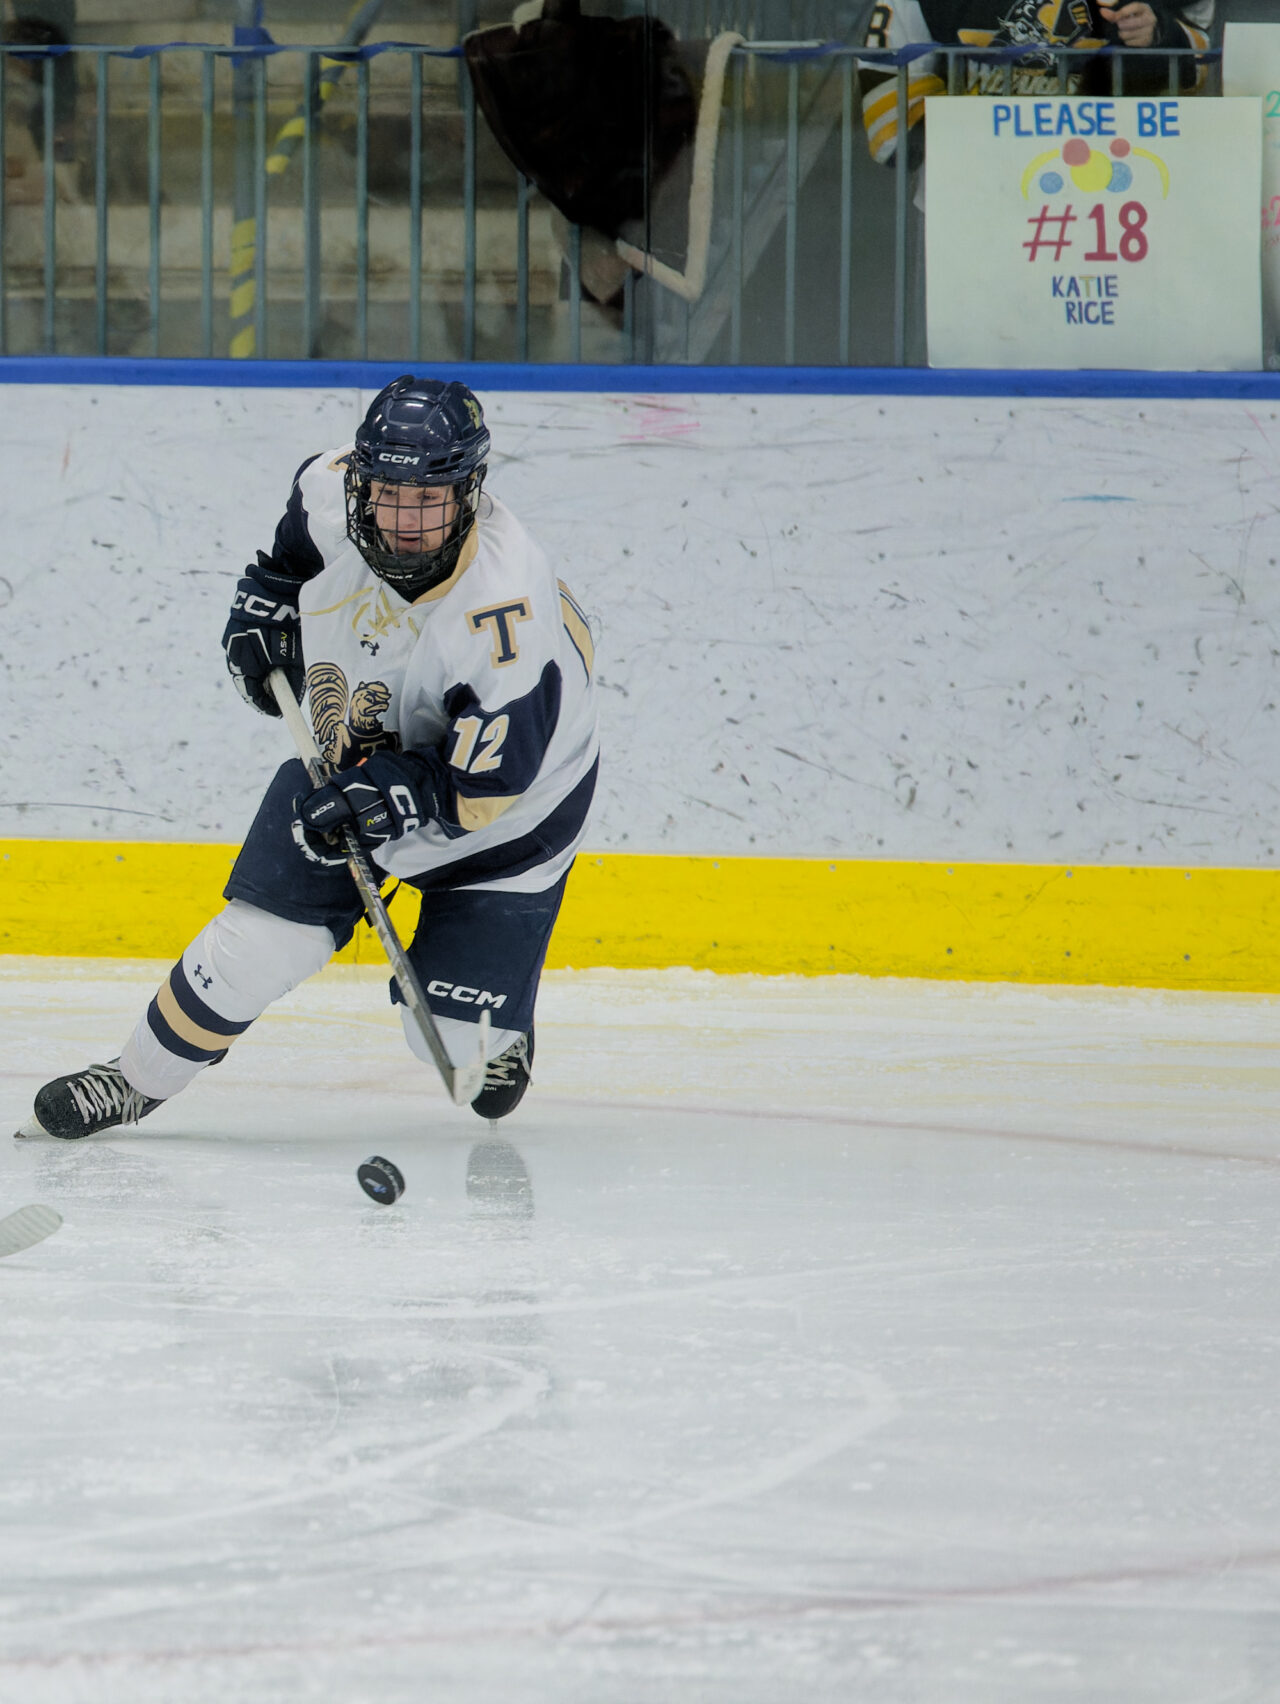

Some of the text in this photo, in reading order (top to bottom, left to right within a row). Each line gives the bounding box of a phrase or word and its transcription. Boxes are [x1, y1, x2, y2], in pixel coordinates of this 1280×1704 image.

[993, 102, 1180, 137] PLEASE BE
[1023, 201, 1149, 263] #18
[1052, 276, 1119, 298] KATIE
[1065, 302, 1115, 326] RICE
[378, 452, 420, 466] CCM
[464, 596, 535, 670] T
[448, 713, 510, 775] 12
[427, 980, 508, 1009] CCM
